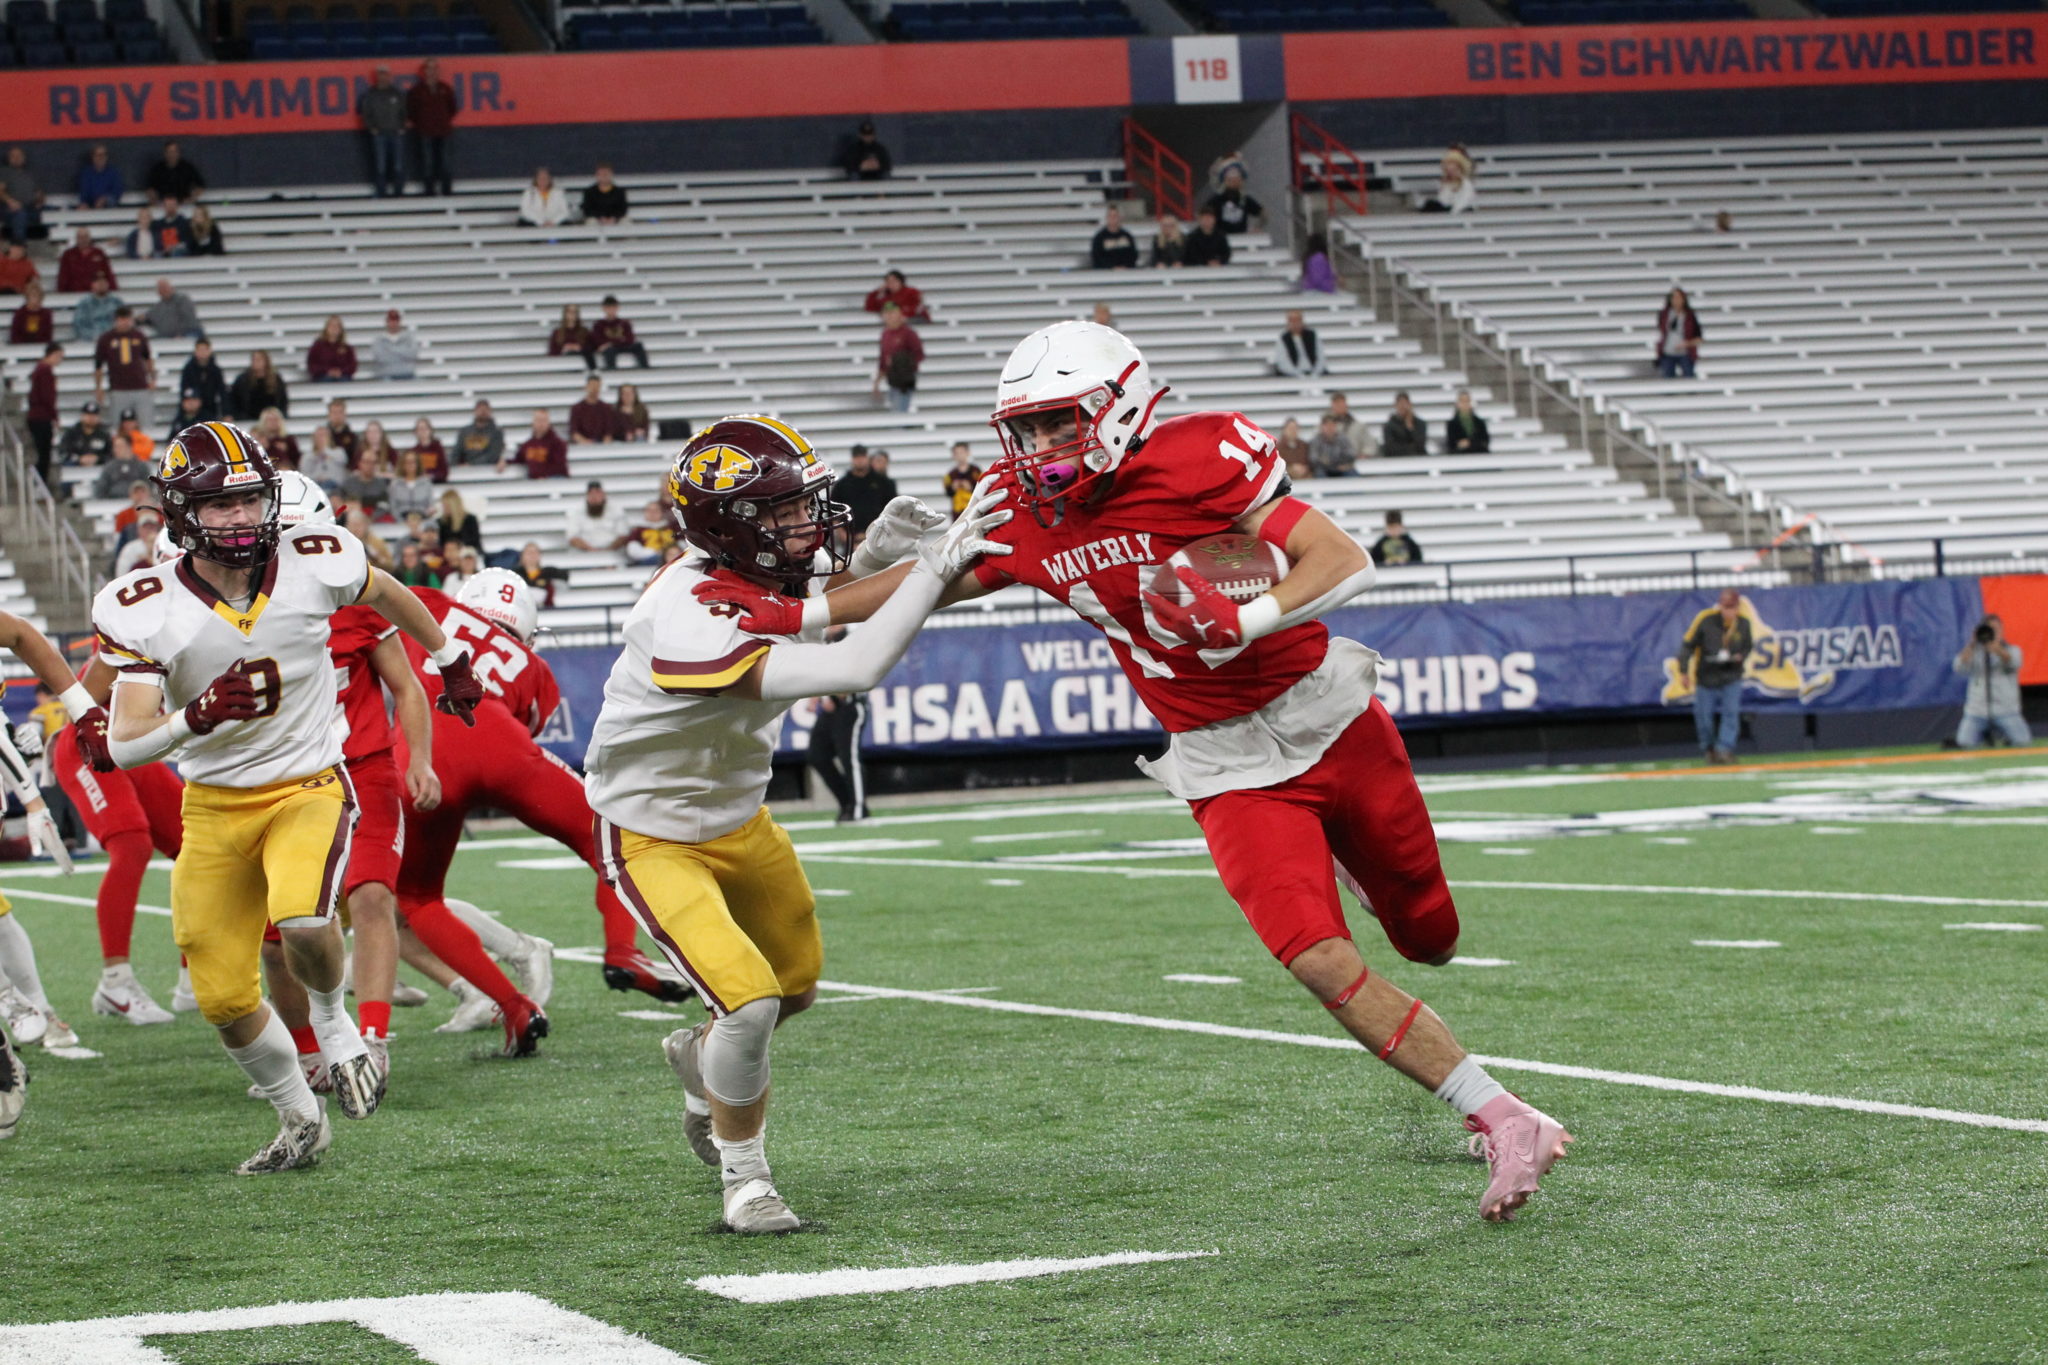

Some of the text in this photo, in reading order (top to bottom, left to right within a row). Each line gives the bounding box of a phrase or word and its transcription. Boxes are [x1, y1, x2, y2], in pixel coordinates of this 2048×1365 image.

[1186, 58, 1229, 81] 118
[1467, 27, 2035, 81] BEN SCHWARTZWALDER
[49, 83, 153, 125] ROY
[169, 75, 422, 121] SIMMO
[1219, 418, 1276, 482] 14
[229, 473, 258, 484] Riddell
[291, 534, 343, 555] 9
[1041, 533, 1156, 585] WAVERLY
[116, 576, 163, 607] 9
[501, 584, 515, 603] 9
[239, 618, 252, 629] FF
[422, 606, 529, 697] 52
[1753, 625, 1902, 670] SPHSAA
